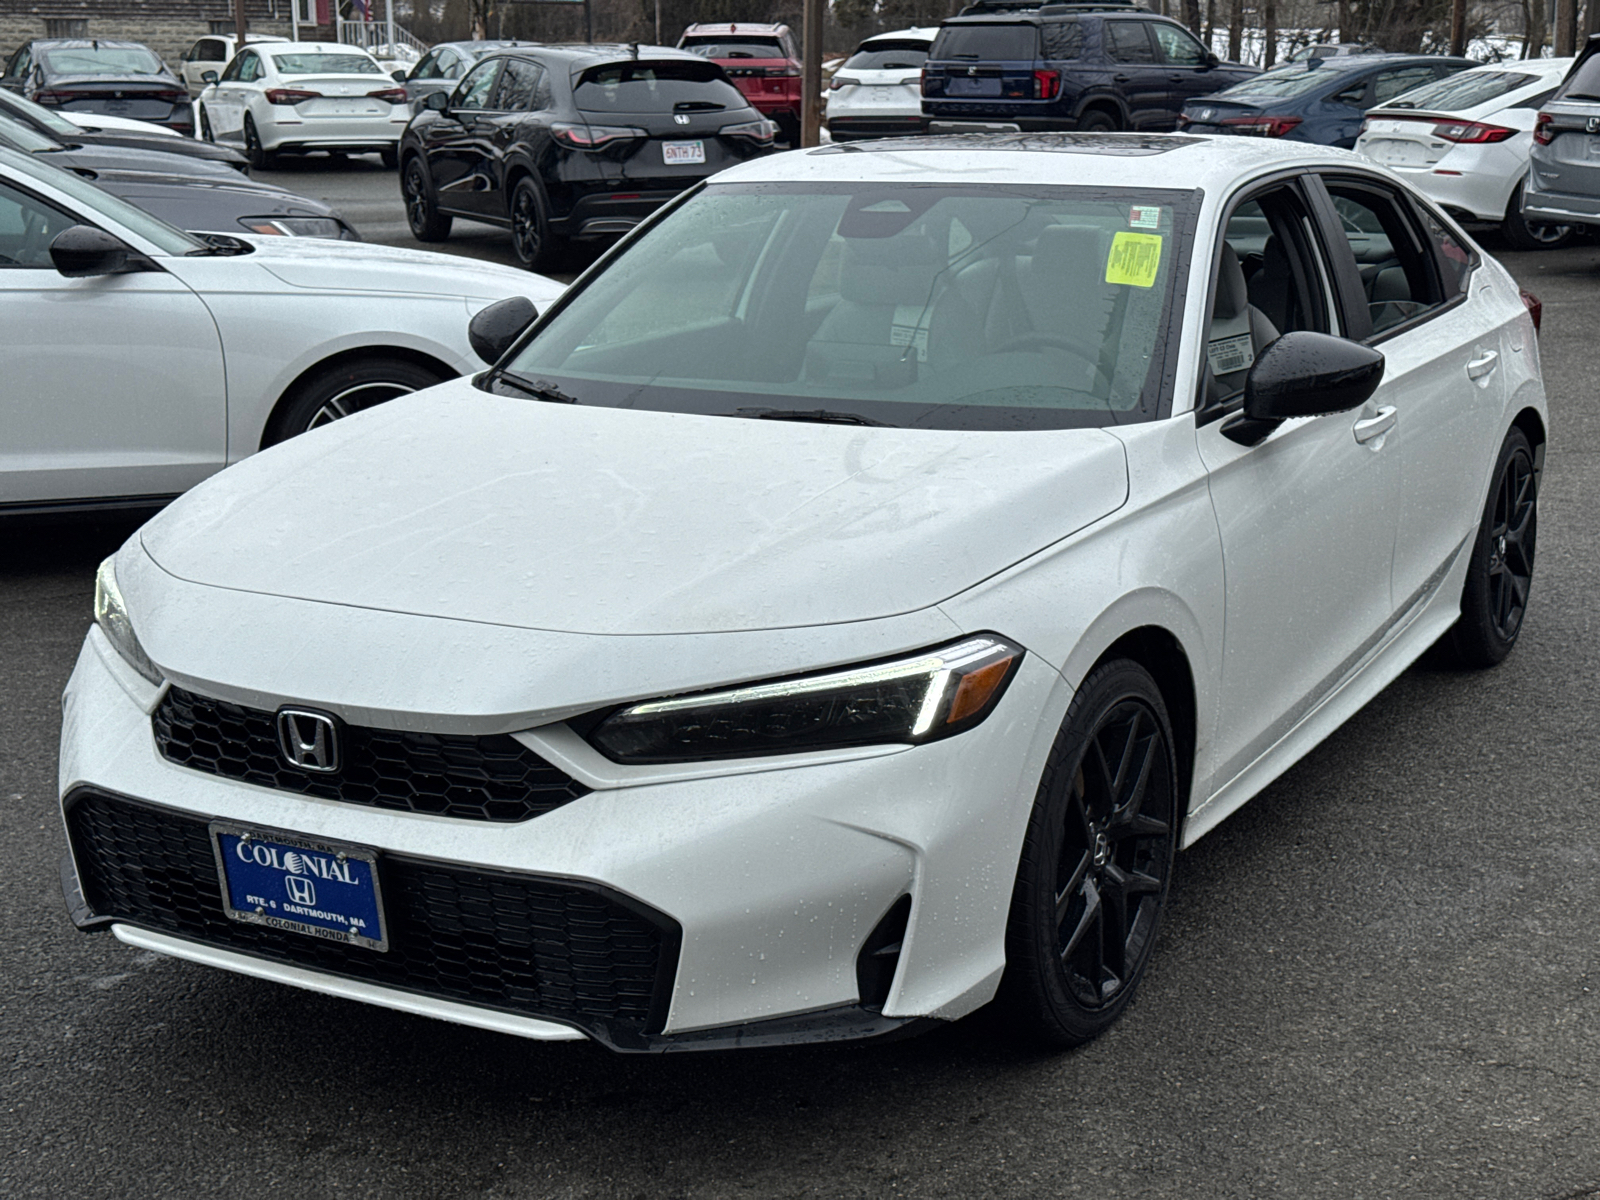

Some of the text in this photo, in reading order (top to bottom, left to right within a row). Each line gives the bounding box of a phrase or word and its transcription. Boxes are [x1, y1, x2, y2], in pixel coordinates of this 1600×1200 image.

[929, 103, 1020, 112] PASSPORT
[236, 841, 359, 885] COLONIAL
[246, 895, 366, 928] RTE. 6 DARTMOUTH, MA
[265, 916, 350, 943] COLONIAL HONDA
